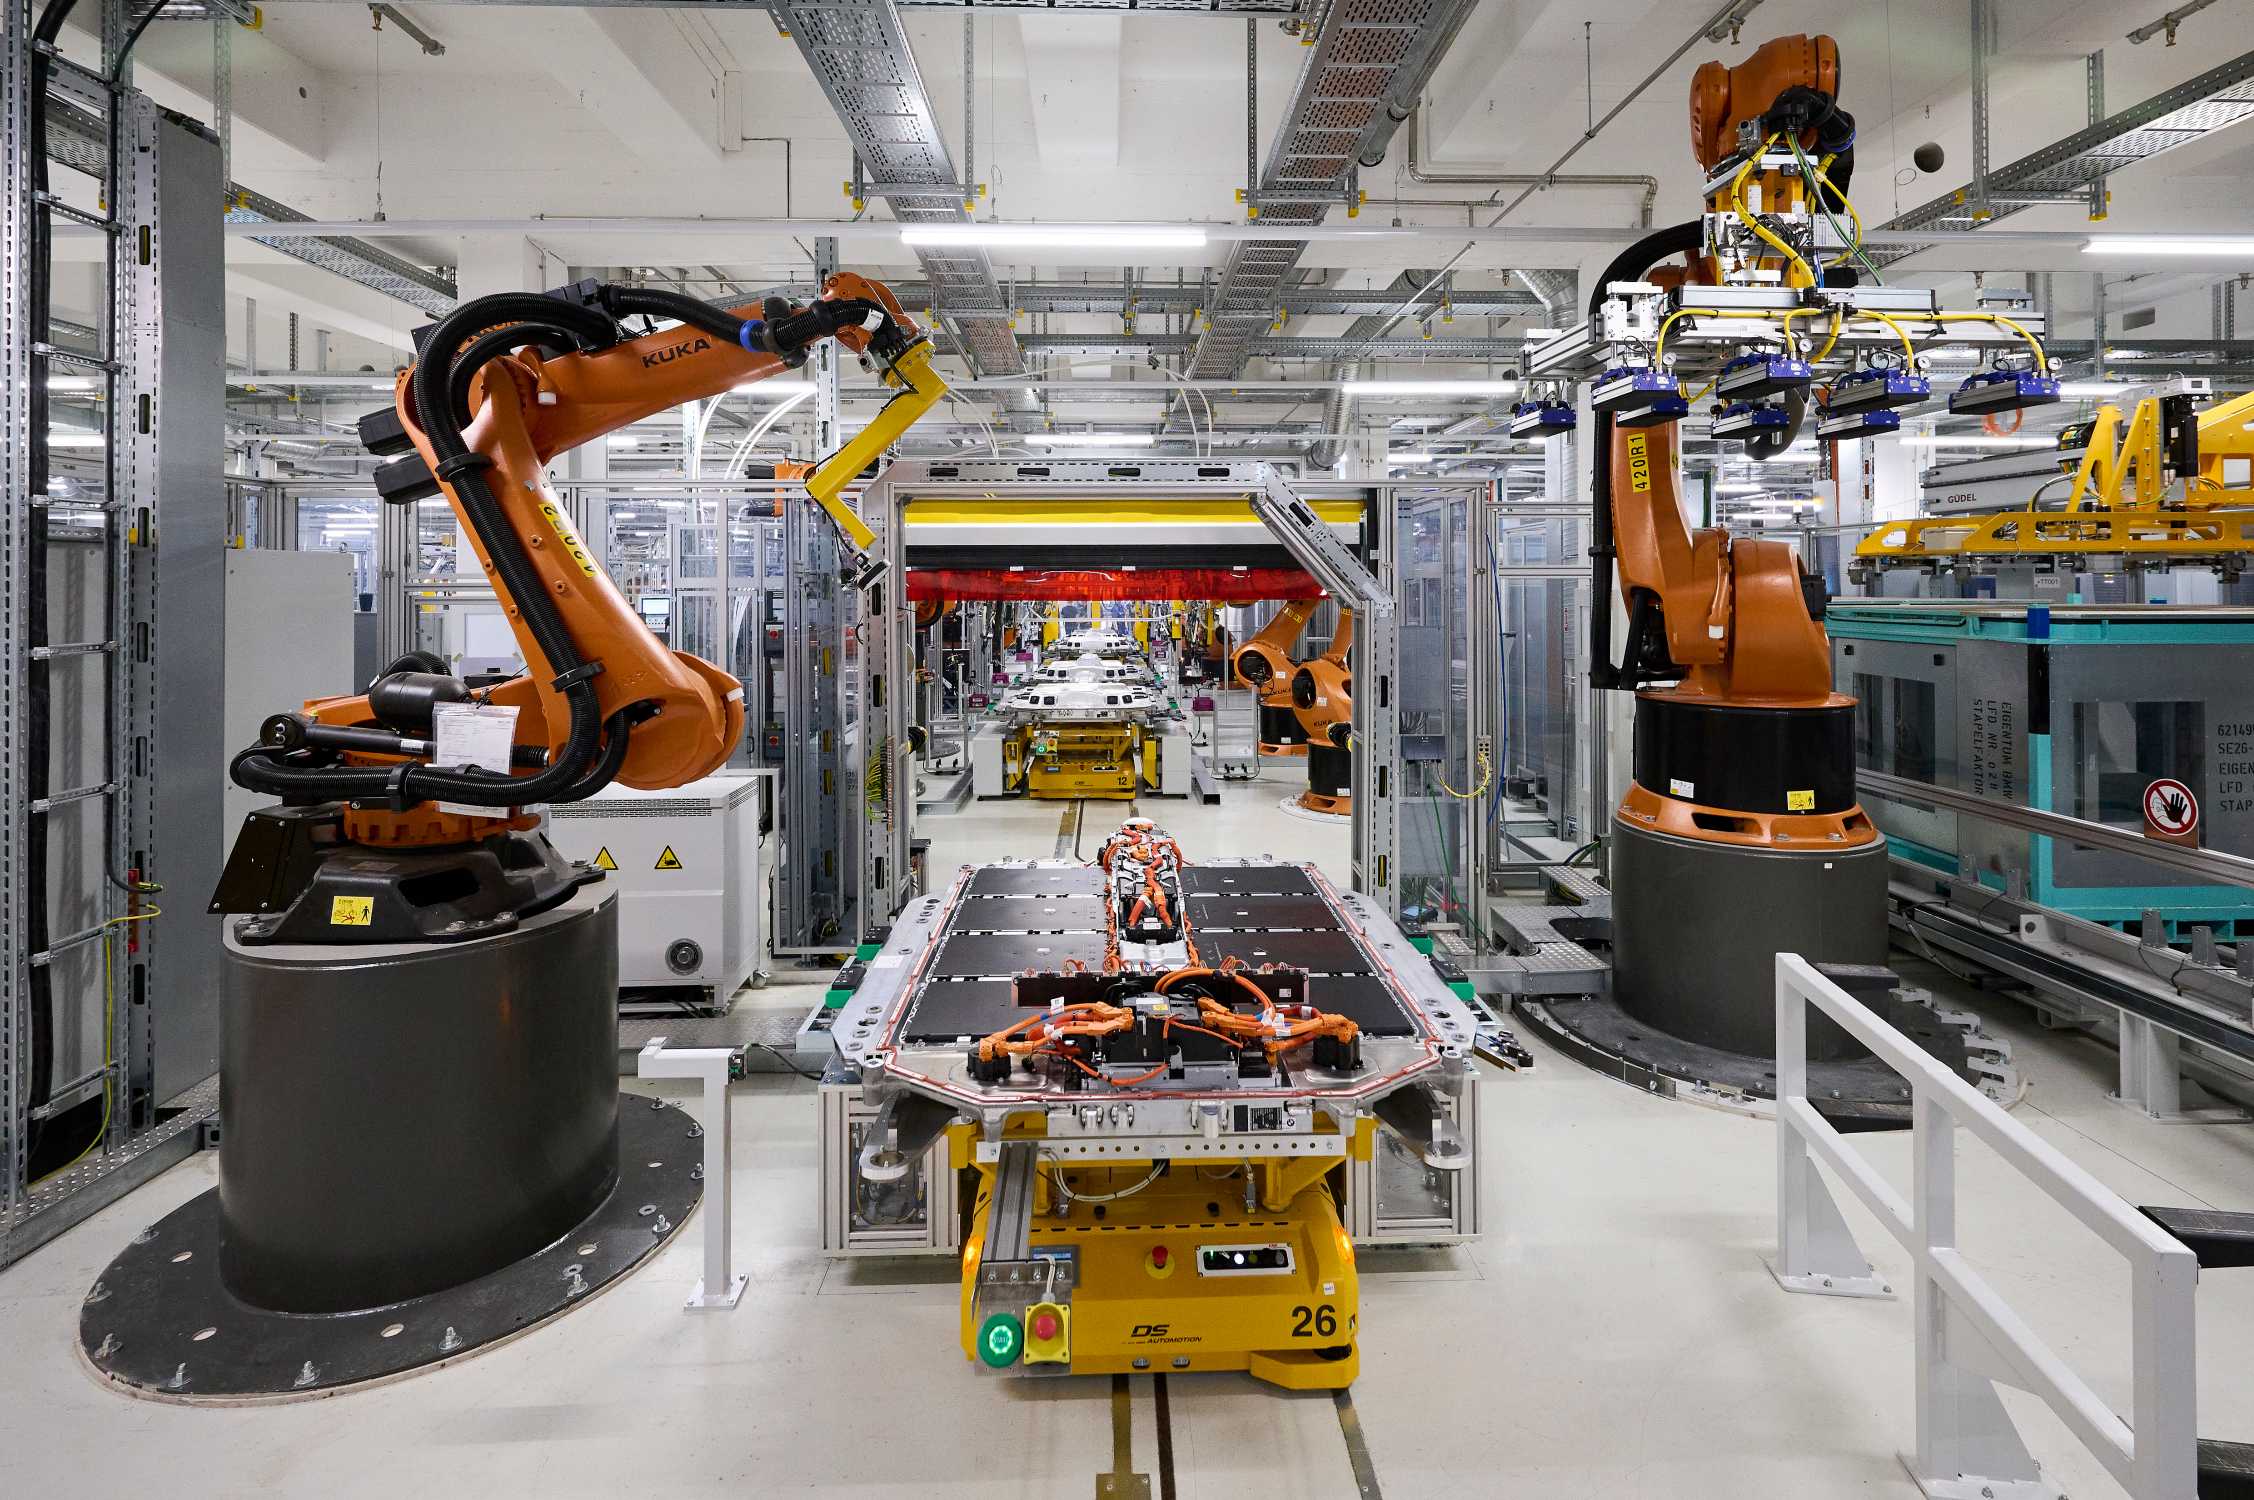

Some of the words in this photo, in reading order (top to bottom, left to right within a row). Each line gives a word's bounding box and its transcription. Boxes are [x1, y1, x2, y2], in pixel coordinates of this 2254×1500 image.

[642, 338, 711, 369] KUKA
[1629, 436, 1648, 489] 420R1
[1947, 493, 1976, 504] GÜDEL
[1973, 699, 1984, 796] STAPELFAKTOR
[2001, 702, 2013, 766] EIGENTUM
[1117, 776, 1128, 786] 12
[1131, 1324, 1170, 1337] DS
[1291, 1304, 1337, 1337] 26
[1147, 1336, 1202, 1344] AUTOMOTION
